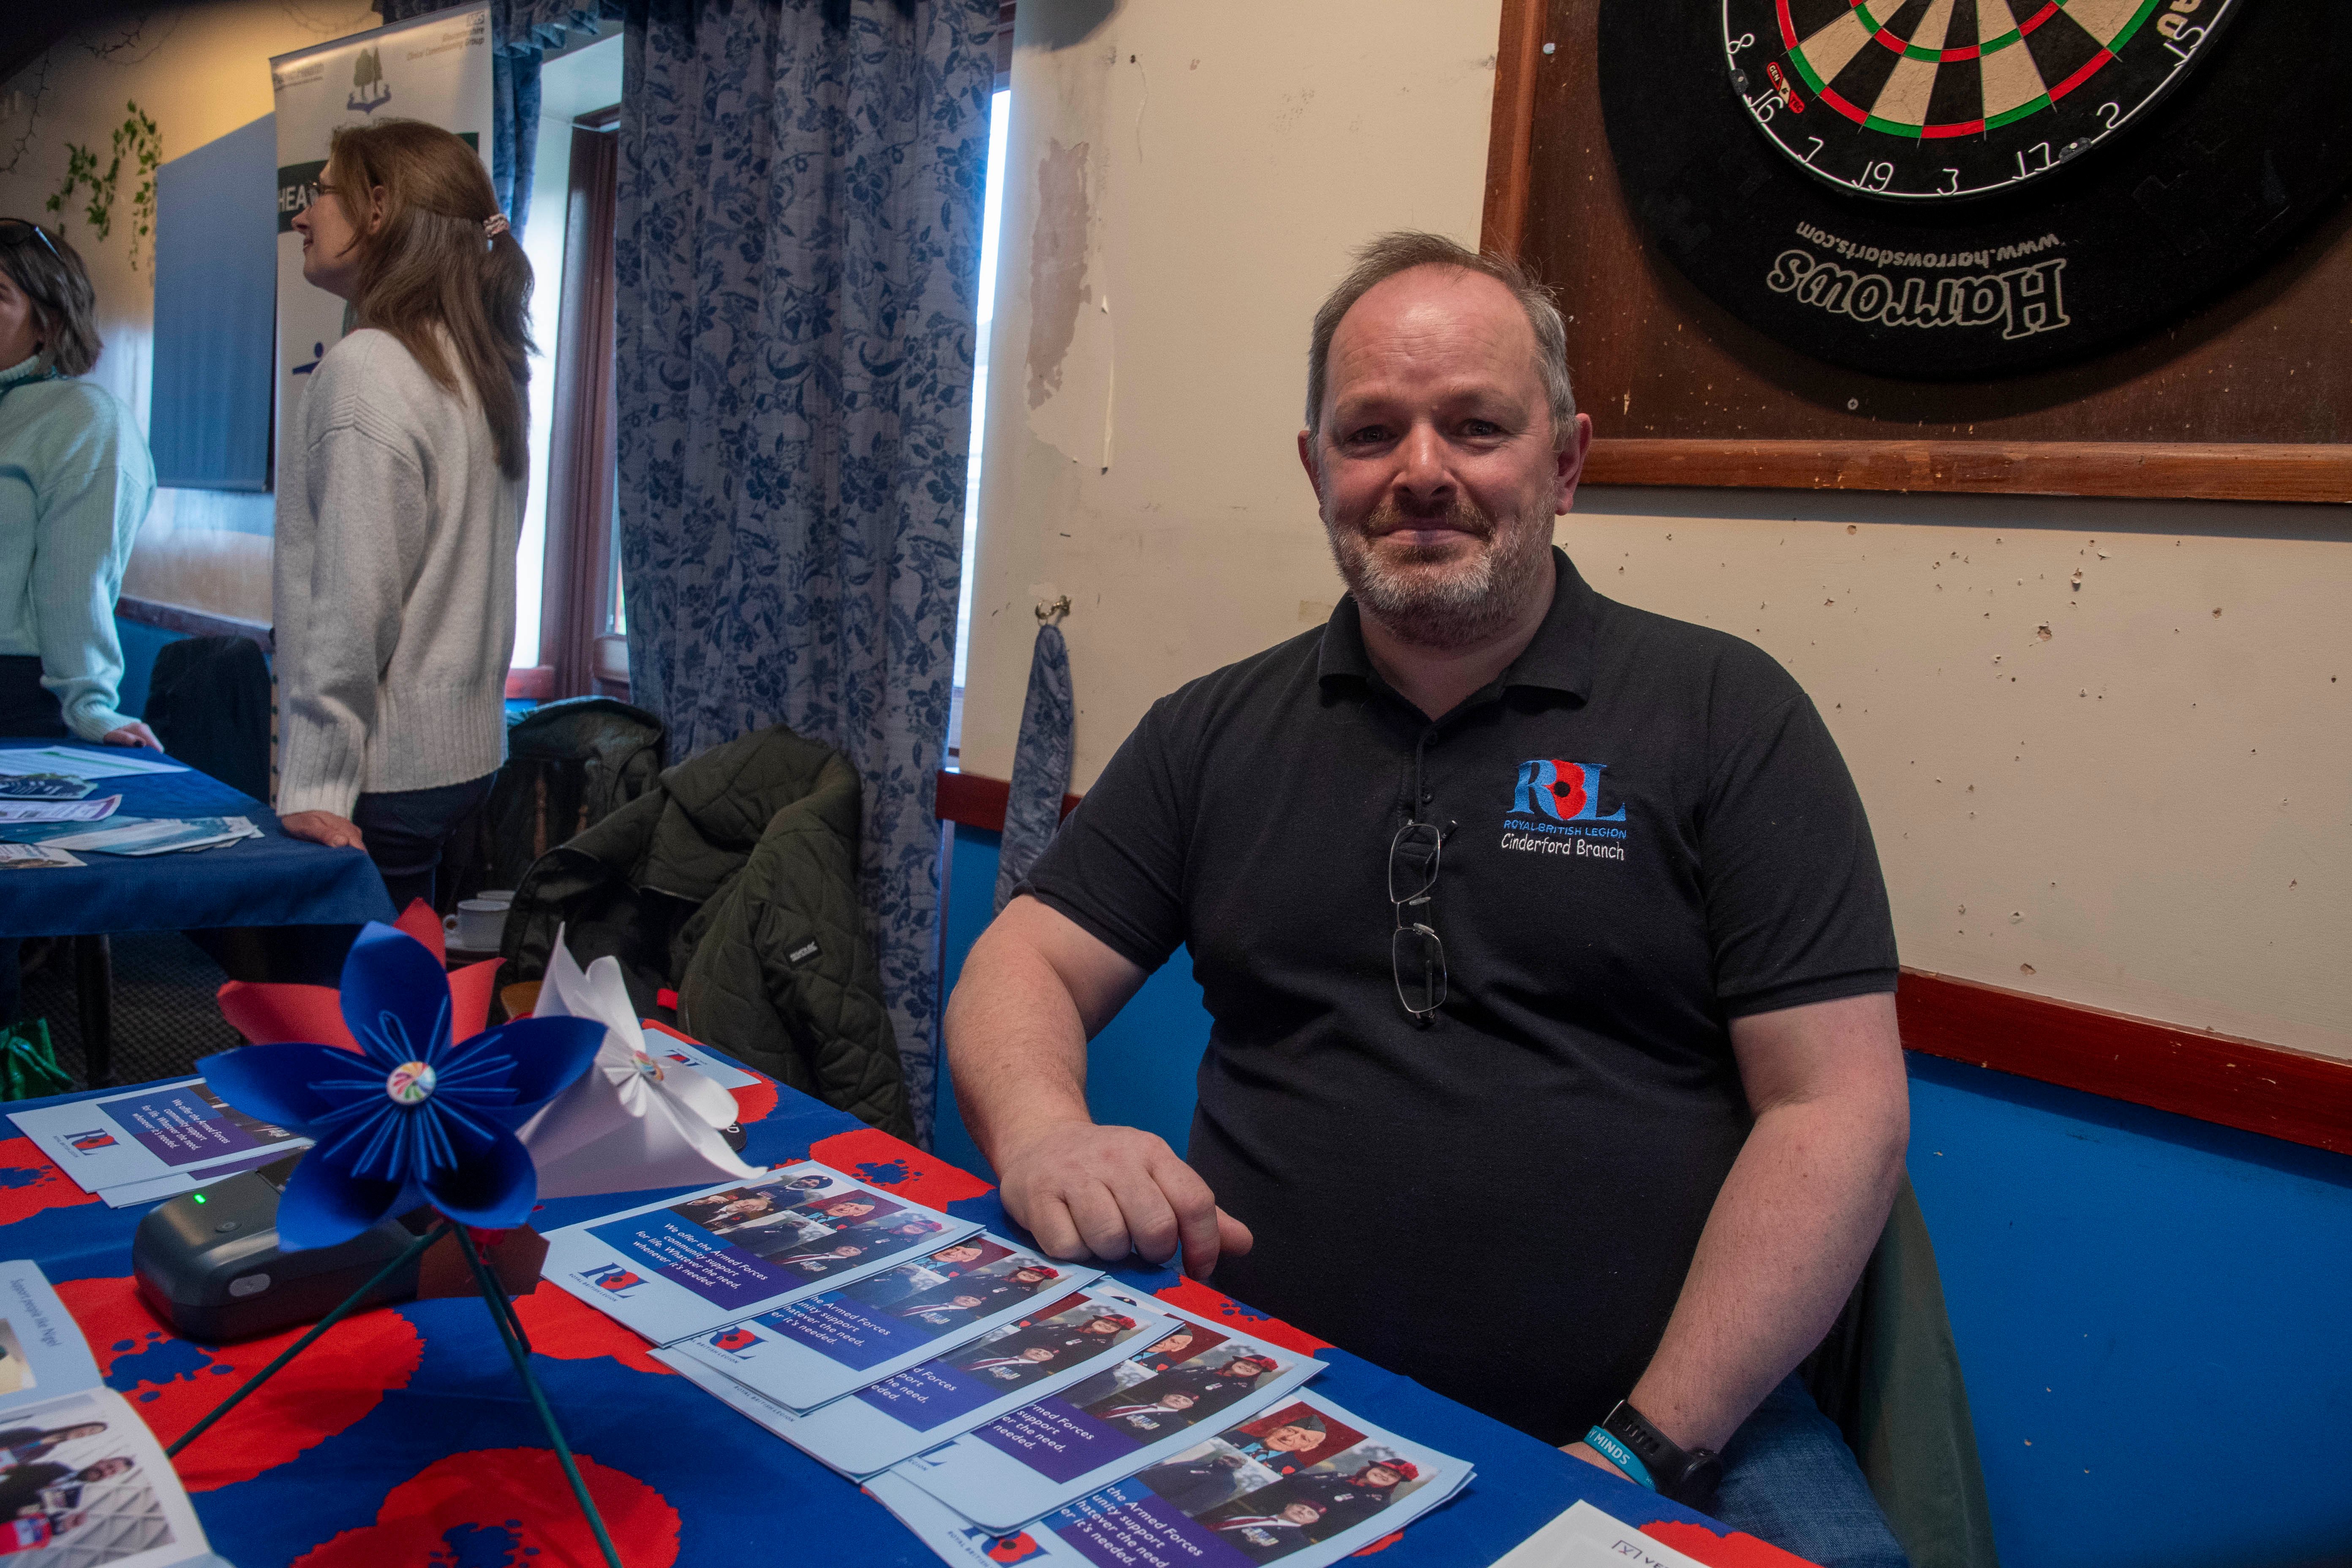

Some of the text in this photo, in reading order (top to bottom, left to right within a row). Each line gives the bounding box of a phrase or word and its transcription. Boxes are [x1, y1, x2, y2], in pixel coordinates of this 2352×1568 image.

[1748, 89, 1783, 123] 16
[2096, 102, 2120, 130] 2
[1798, 136, 1824, 164] 7
[2012, 142, 2050, 181] 17
[1851, 161, 1893, 193] 19
[1936, 168, 1959, 196] 3
[278, 184, 309, 212] HEA
[1796, 221, 2060, 269] www.harrowsdarts.com
[1767, 249, 2070, 340] Harrows
[1504, 819, 1627, 839] ROYAL BRITISH LEGION
[1501, 833, 1625, 861] Cinderford Branch
[157, 1116, 180, 1134] Whatever
[163, 1108, 207, 1141] community support
[196, 1119, 218, 1135] Armed
[212, 1131, 231, 1144] Forces
[633, 1241, 716, 1287] whenever it's needed.
[635, 1230, 741, 1289] for life. Whatever the need,
[663, 1235, 739, 1277] community support
[664, 1222, 768, 1281] We offer the Armed Forces
[568, 1273, 618, 1302] ROYAL BRITISH LEGION
[783, 1305, 865, 1347] hatever the need,
[783, 1317, 800, 1326] it's
[798, 1324, 838, 1345] needed.
[810, 1296, 891, 1336] he Armed Forces
[820, 1312, 860, 1333] support
[871, 1384, 901, 1401] eded.
[885, 1377, 929, 1403] he need,
[896, 1373, 924, 1388] port
[922, 1371, 957, 1391] Forces
[993, 1424, 1037, 1450] needed.
[1015, 1422, 1035, 1435] the
[1035, 1433, 1067, 1453] need,
[1017, 1410, 1060, 1435] support
[1030, 1404, 1095, 1440] rmed Forces
[1594, 1432, 1631, 1465] MINDS
[1061, 1508, 1137, 1566] er it's needed.
[1076, 1500, 1119, 1532] hatever
[1116, 1531, 1138, 1547] the
[1092, 1494, 1165, 1549] unity support
[1106, 1486, 1203, 1557] the Armed Forces
